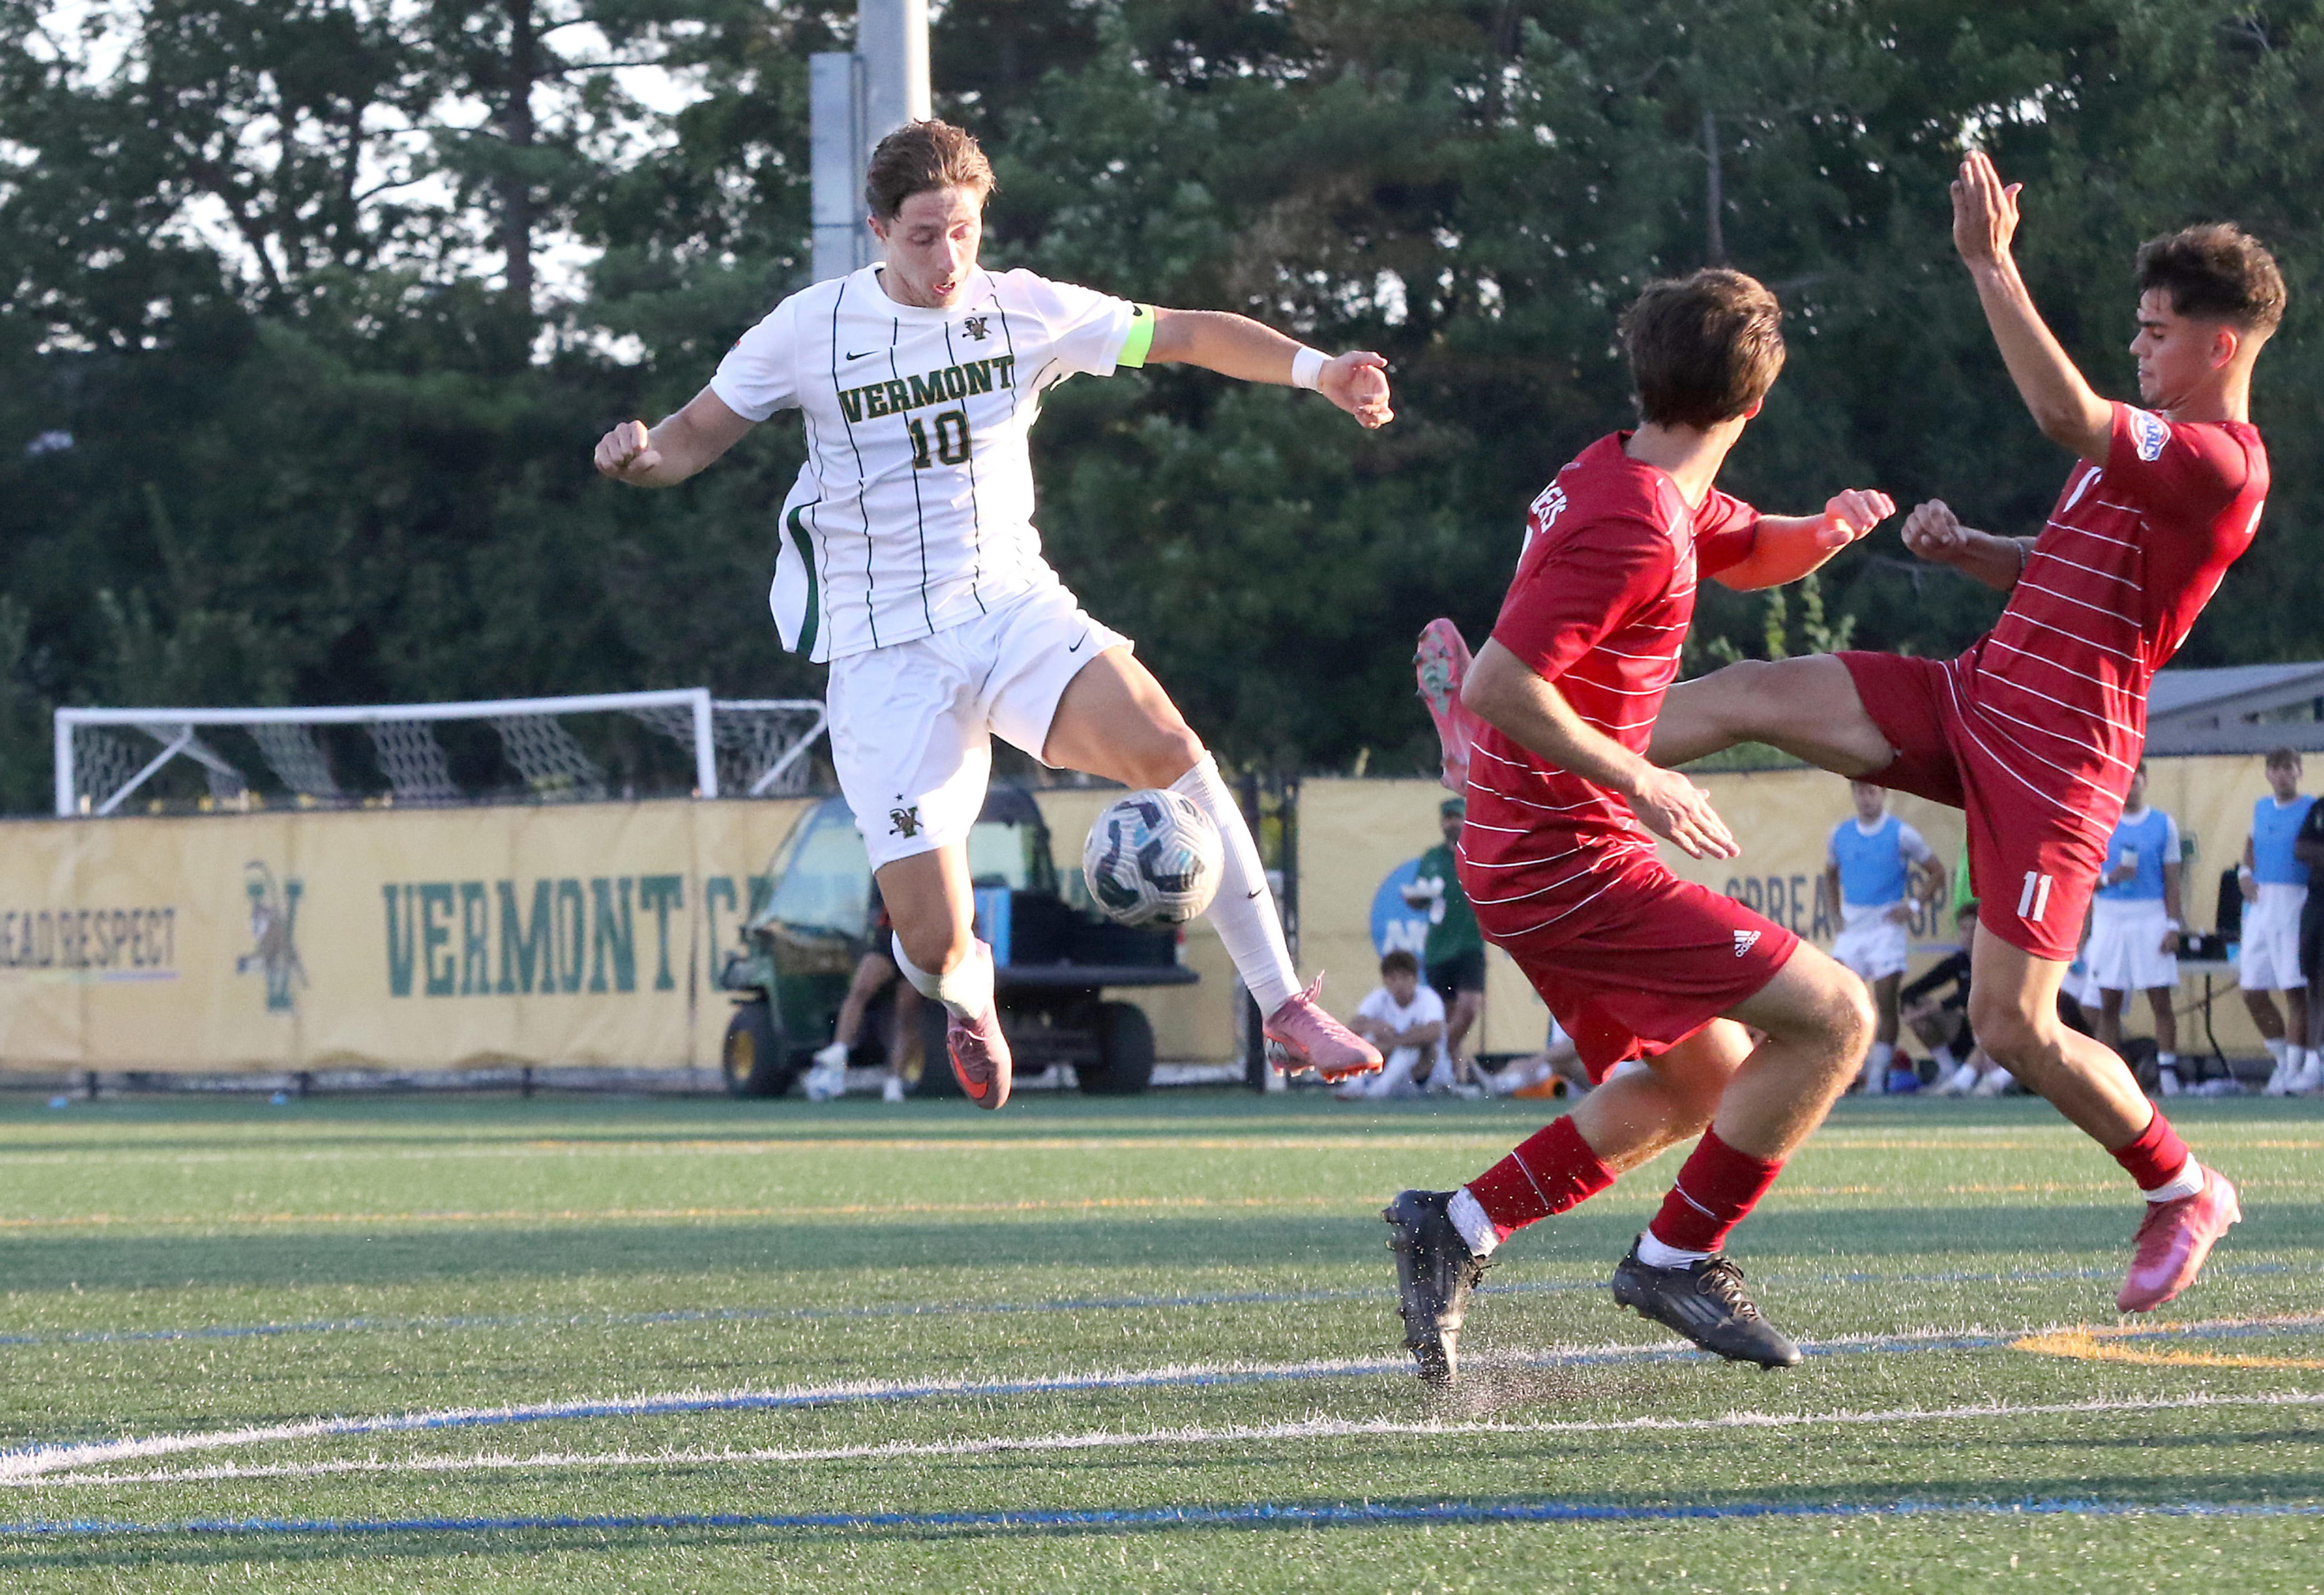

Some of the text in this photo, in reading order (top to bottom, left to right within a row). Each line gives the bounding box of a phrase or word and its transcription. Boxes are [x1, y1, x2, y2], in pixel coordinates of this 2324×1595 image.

[837, 354, 1015, 424] VERMONT
[909, 409, 973, 470] 10
[1530, 479, 1568, 534] ERS
[2017, 870, 2053, 922] 11
[382, 875, 684, 997] VERMONT
[1735, 930, 1762, 958] adidas
